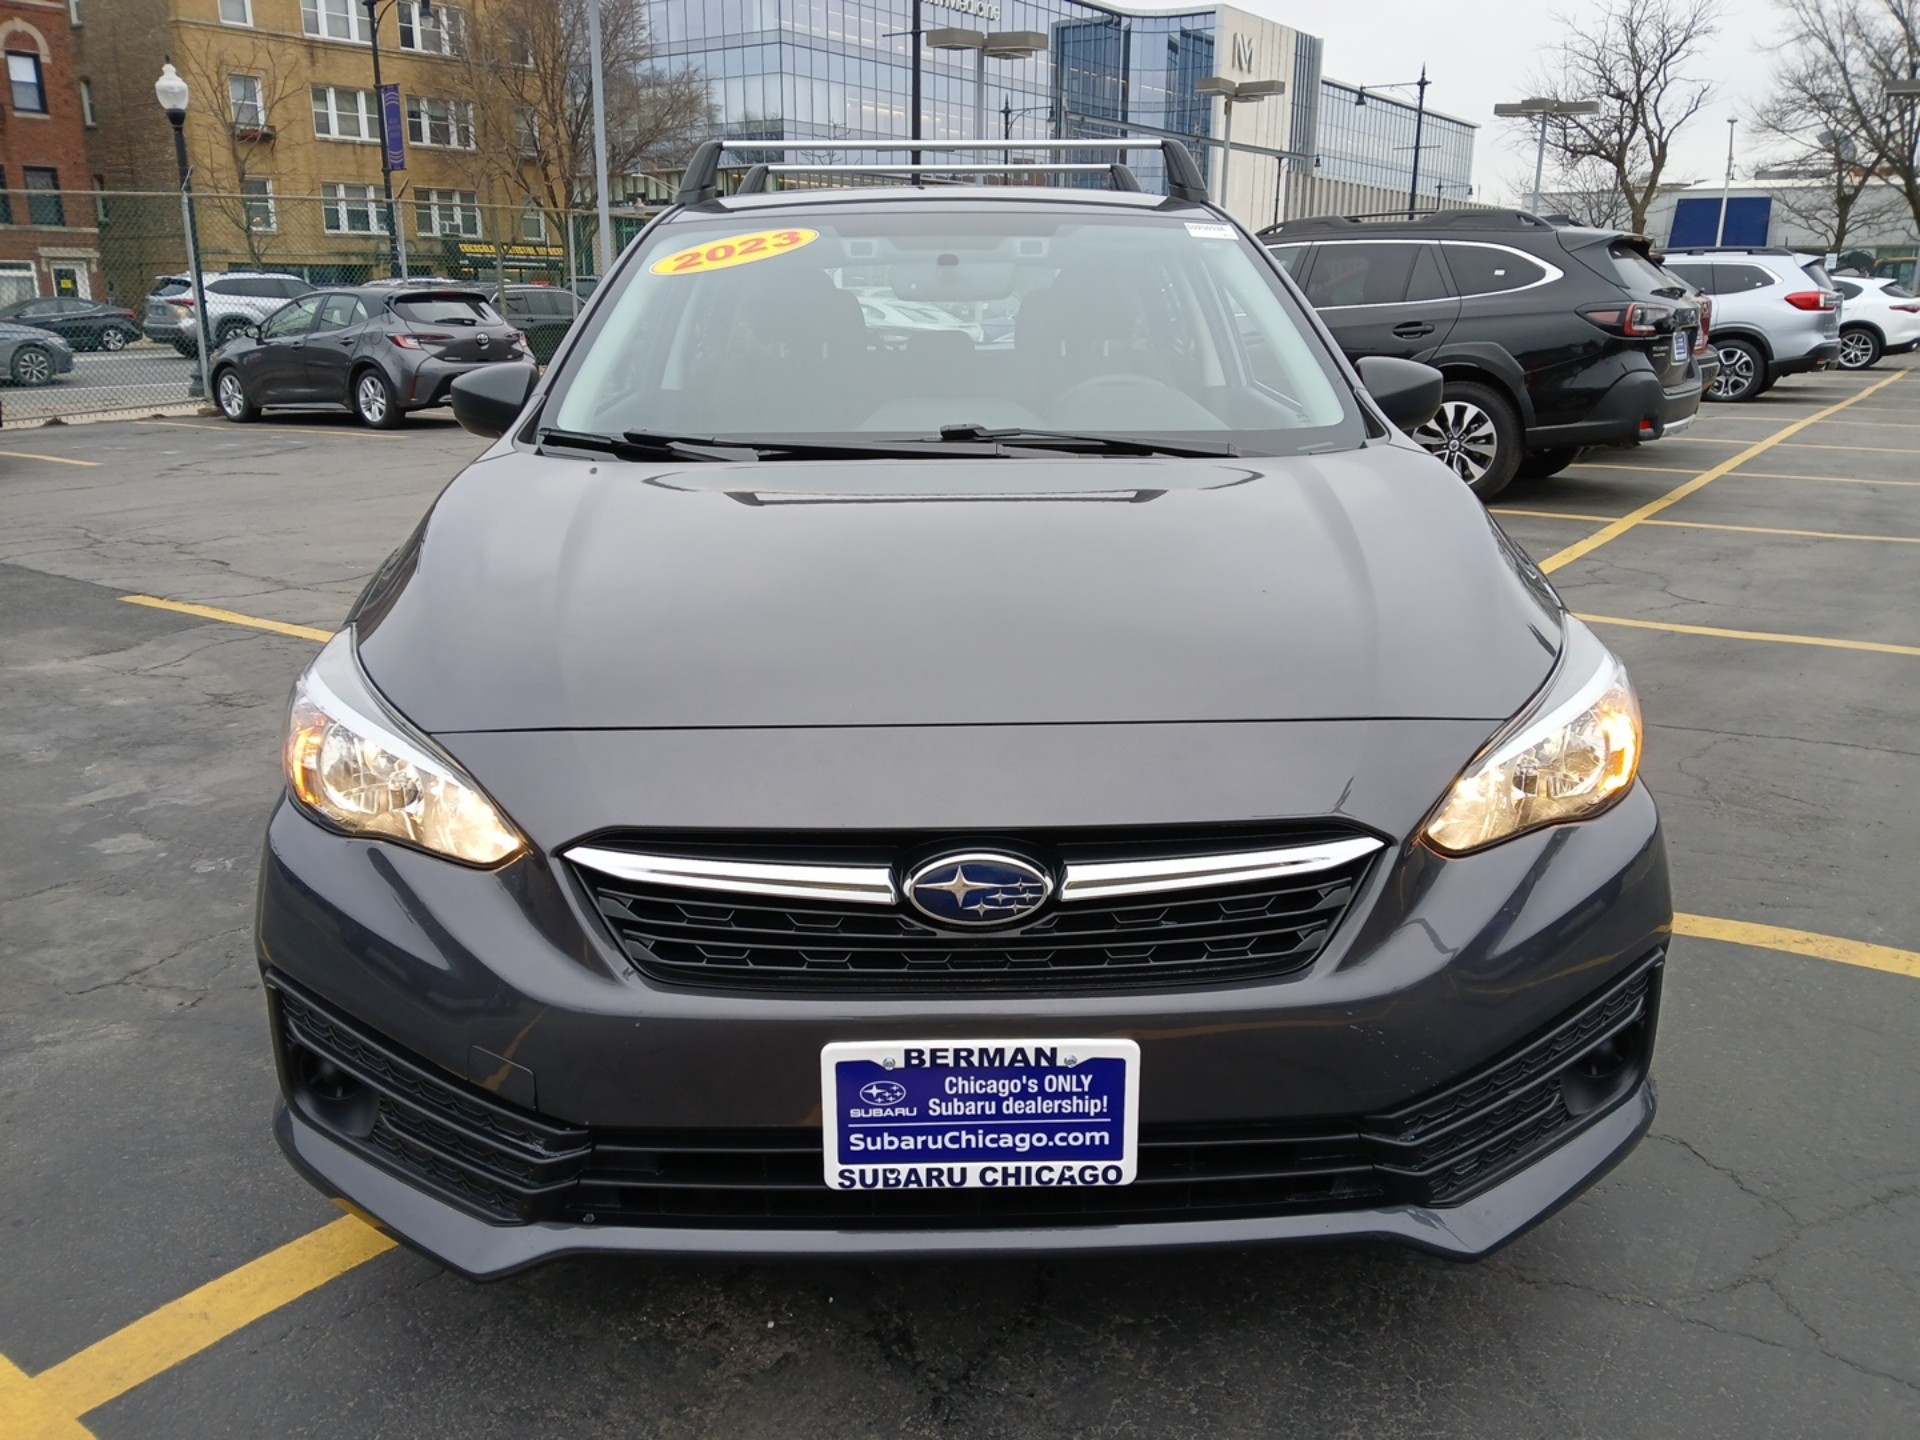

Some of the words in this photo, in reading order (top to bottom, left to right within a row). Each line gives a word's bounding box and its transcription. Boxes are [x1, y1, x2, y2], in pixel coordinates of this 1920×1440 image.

[671, 230, 804, 272] 2023
[903, 1046, 1058, 1068] BERMAN
[944, 1075, 1039, 1097] Chicago's
[1043, 1074, 1094, 1093] ONLY
[849, 1107, 917, 1118] SUBARU
[928, 1098, 997, 1116] Subaru
[1002, 1095, 1108, 1117] dealership!
[849, 1129, 1110, 1152] SubaruChicago.com
[837, 1166, 968, 1189] SUBARU
[978, 1164, 1123, 1187] CHICAGO
